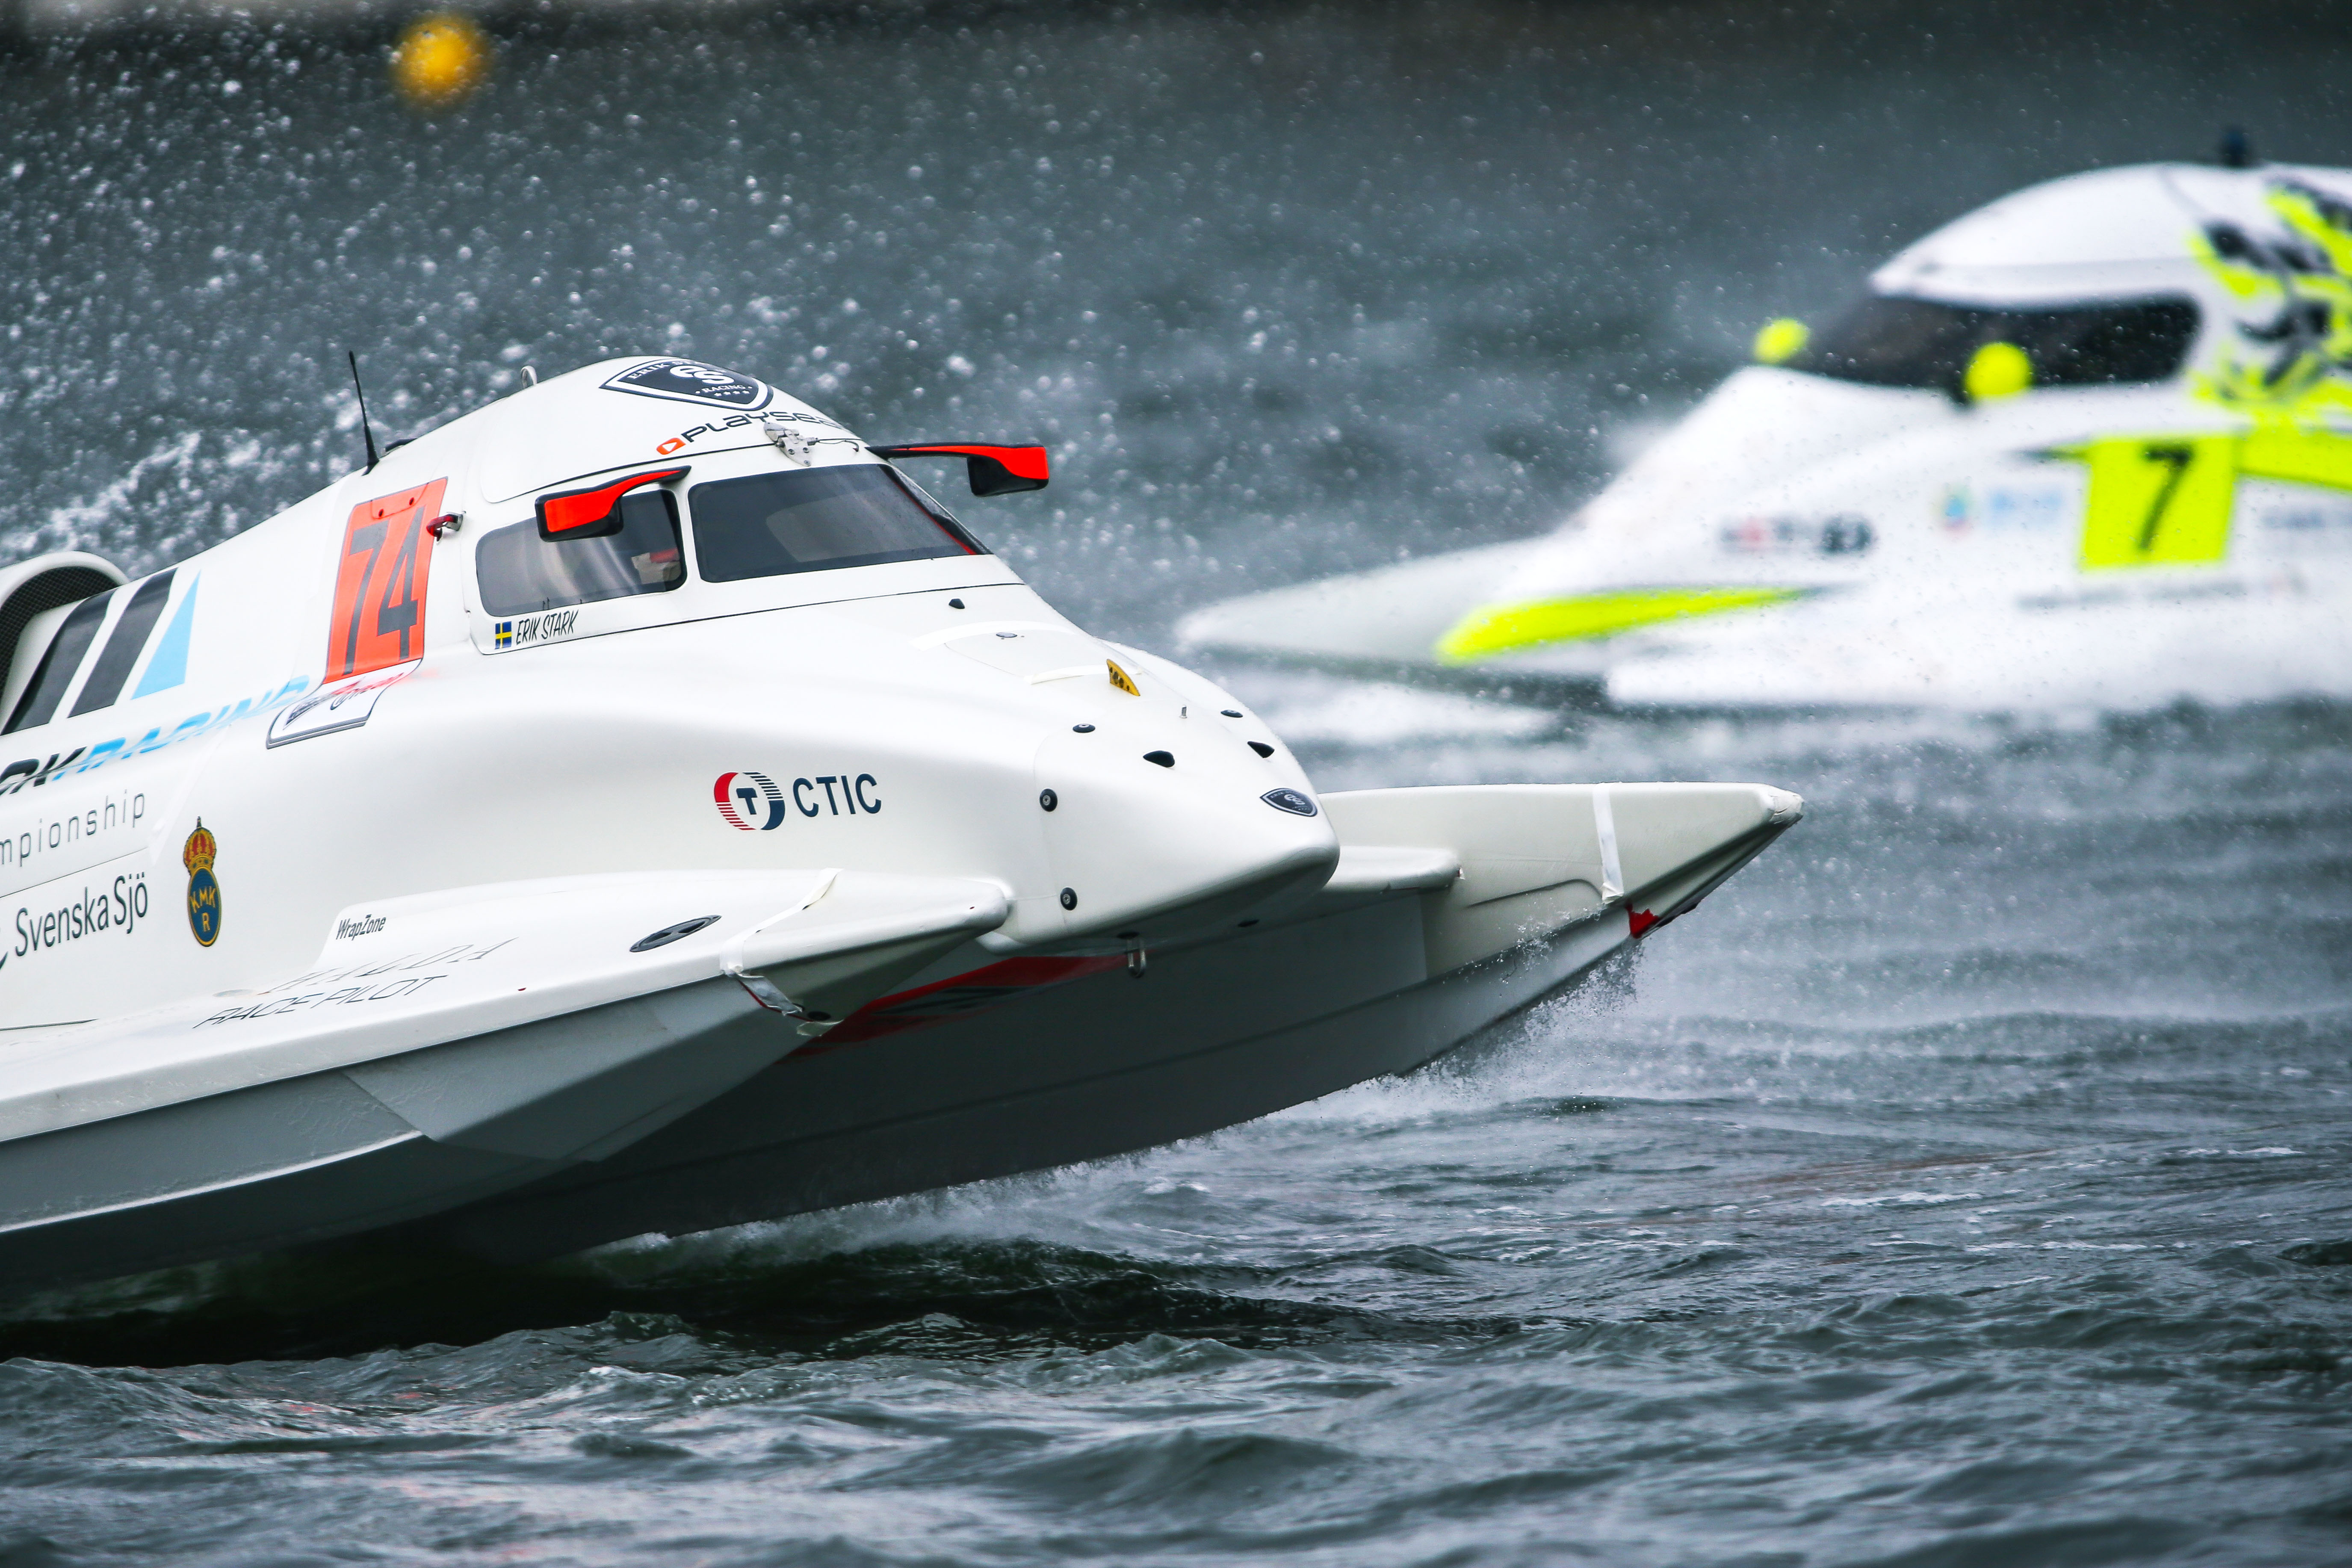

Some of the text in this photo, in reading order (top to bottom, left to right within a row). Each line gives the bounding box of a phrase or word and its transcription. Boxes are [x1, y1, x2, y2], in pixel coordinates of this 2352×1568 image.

[627, 362, 670, 380] ERIK
[703, 384, 746, 393] RACING
[2140, 441, 2195, 552] 7
[343, 506, 425, 676] 74
[516, 608, 579, 645] ERIK STARK
[792, 773, 882, 818] CTIC
[189, 885, 217, 914] KMK
[202, 912, 211, 932] R
[336, 914, 386, 941] WrapZone
[192, 974, 449, 1029] RACE PILOT
